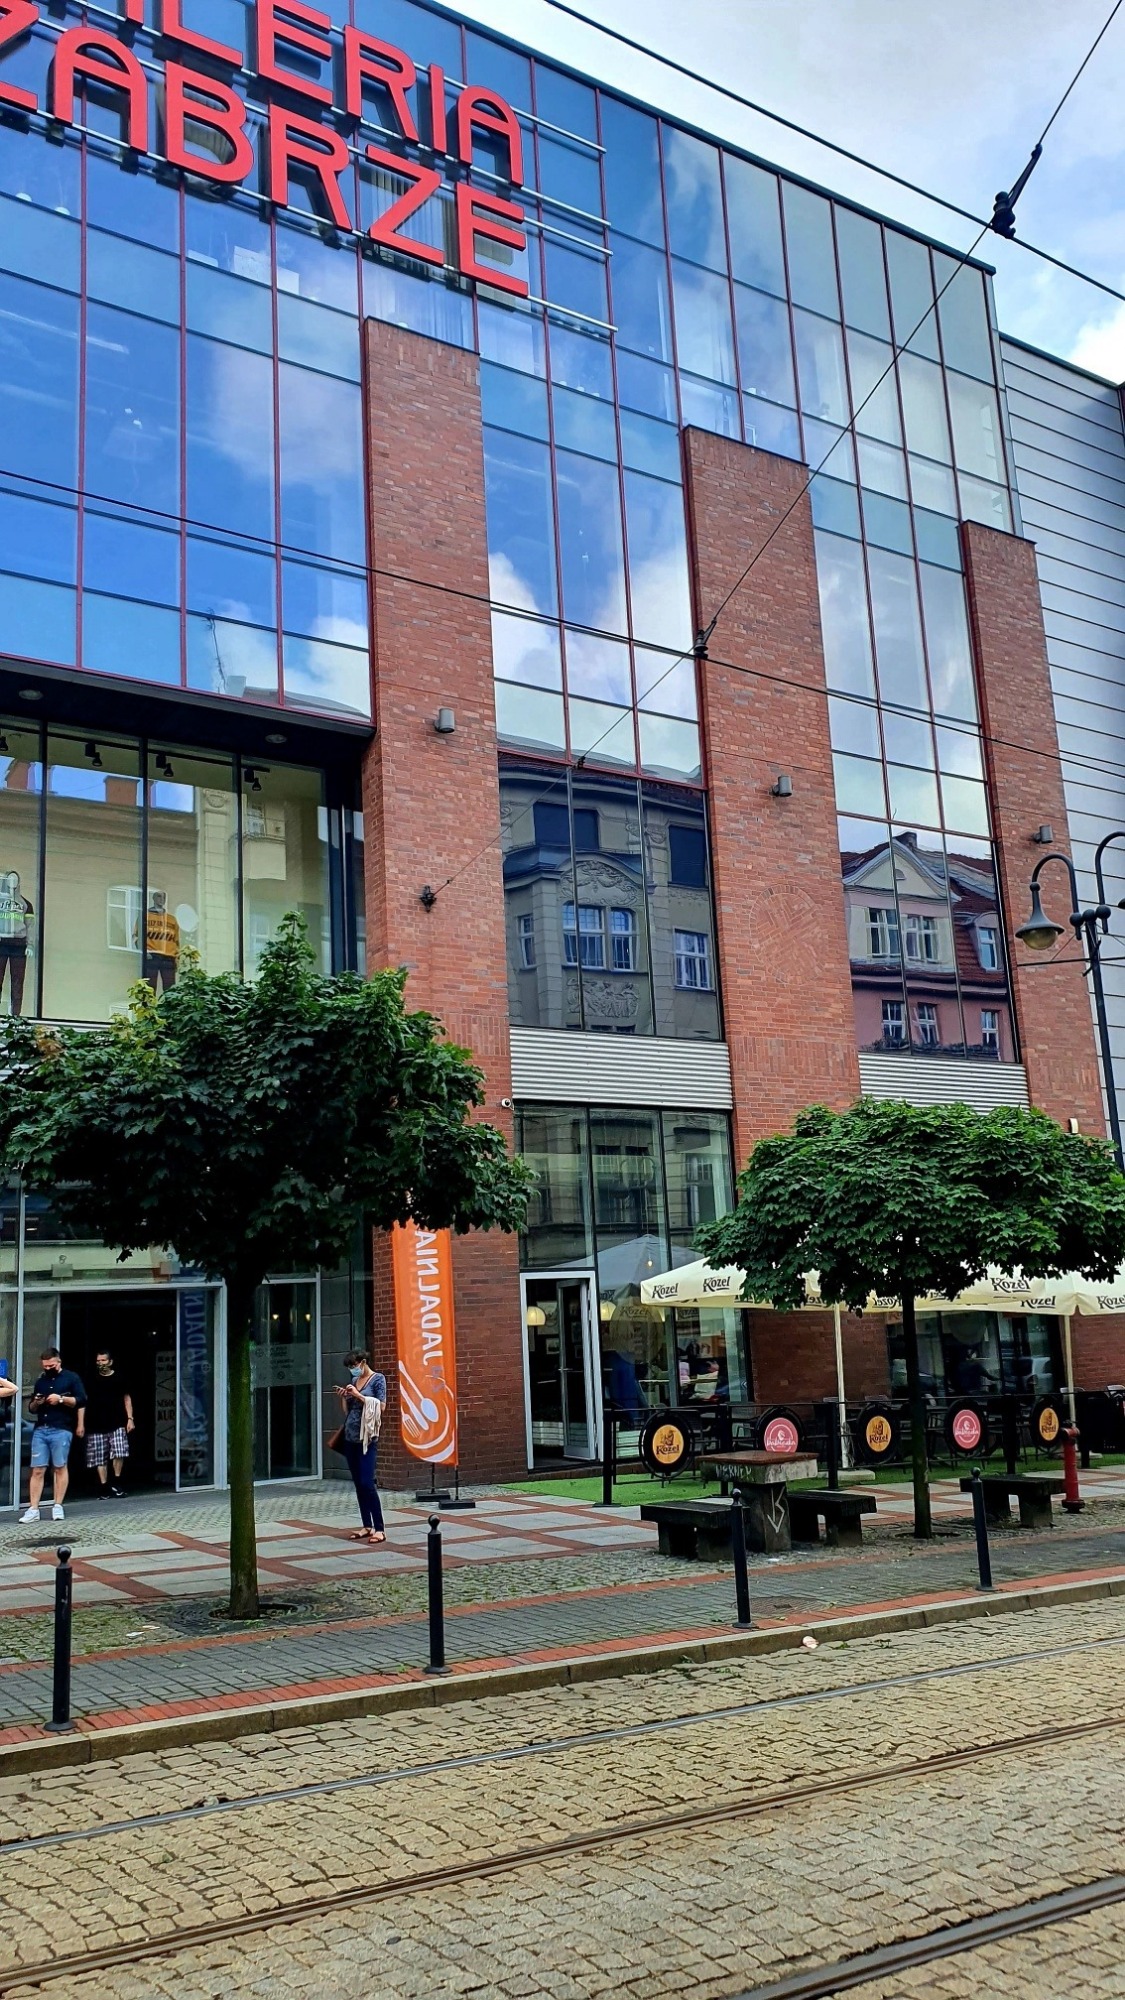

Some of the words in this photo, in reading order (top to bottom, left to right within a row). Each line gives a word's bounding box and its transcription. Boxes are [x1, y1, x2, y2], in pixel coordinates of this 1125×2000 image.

[126, 0, 524, 188] LERIA
[652, 1283, 678, 1299] Kozel
[703, 1276, 730, 1292] Kozel
[991, 1277, 1031, 1293] Kozel
[1096, 1295, 1125, 1310] Koze
[869, 1434, 888, 1444] Kozel
[656, 1444, 680, 1455] Kozel
